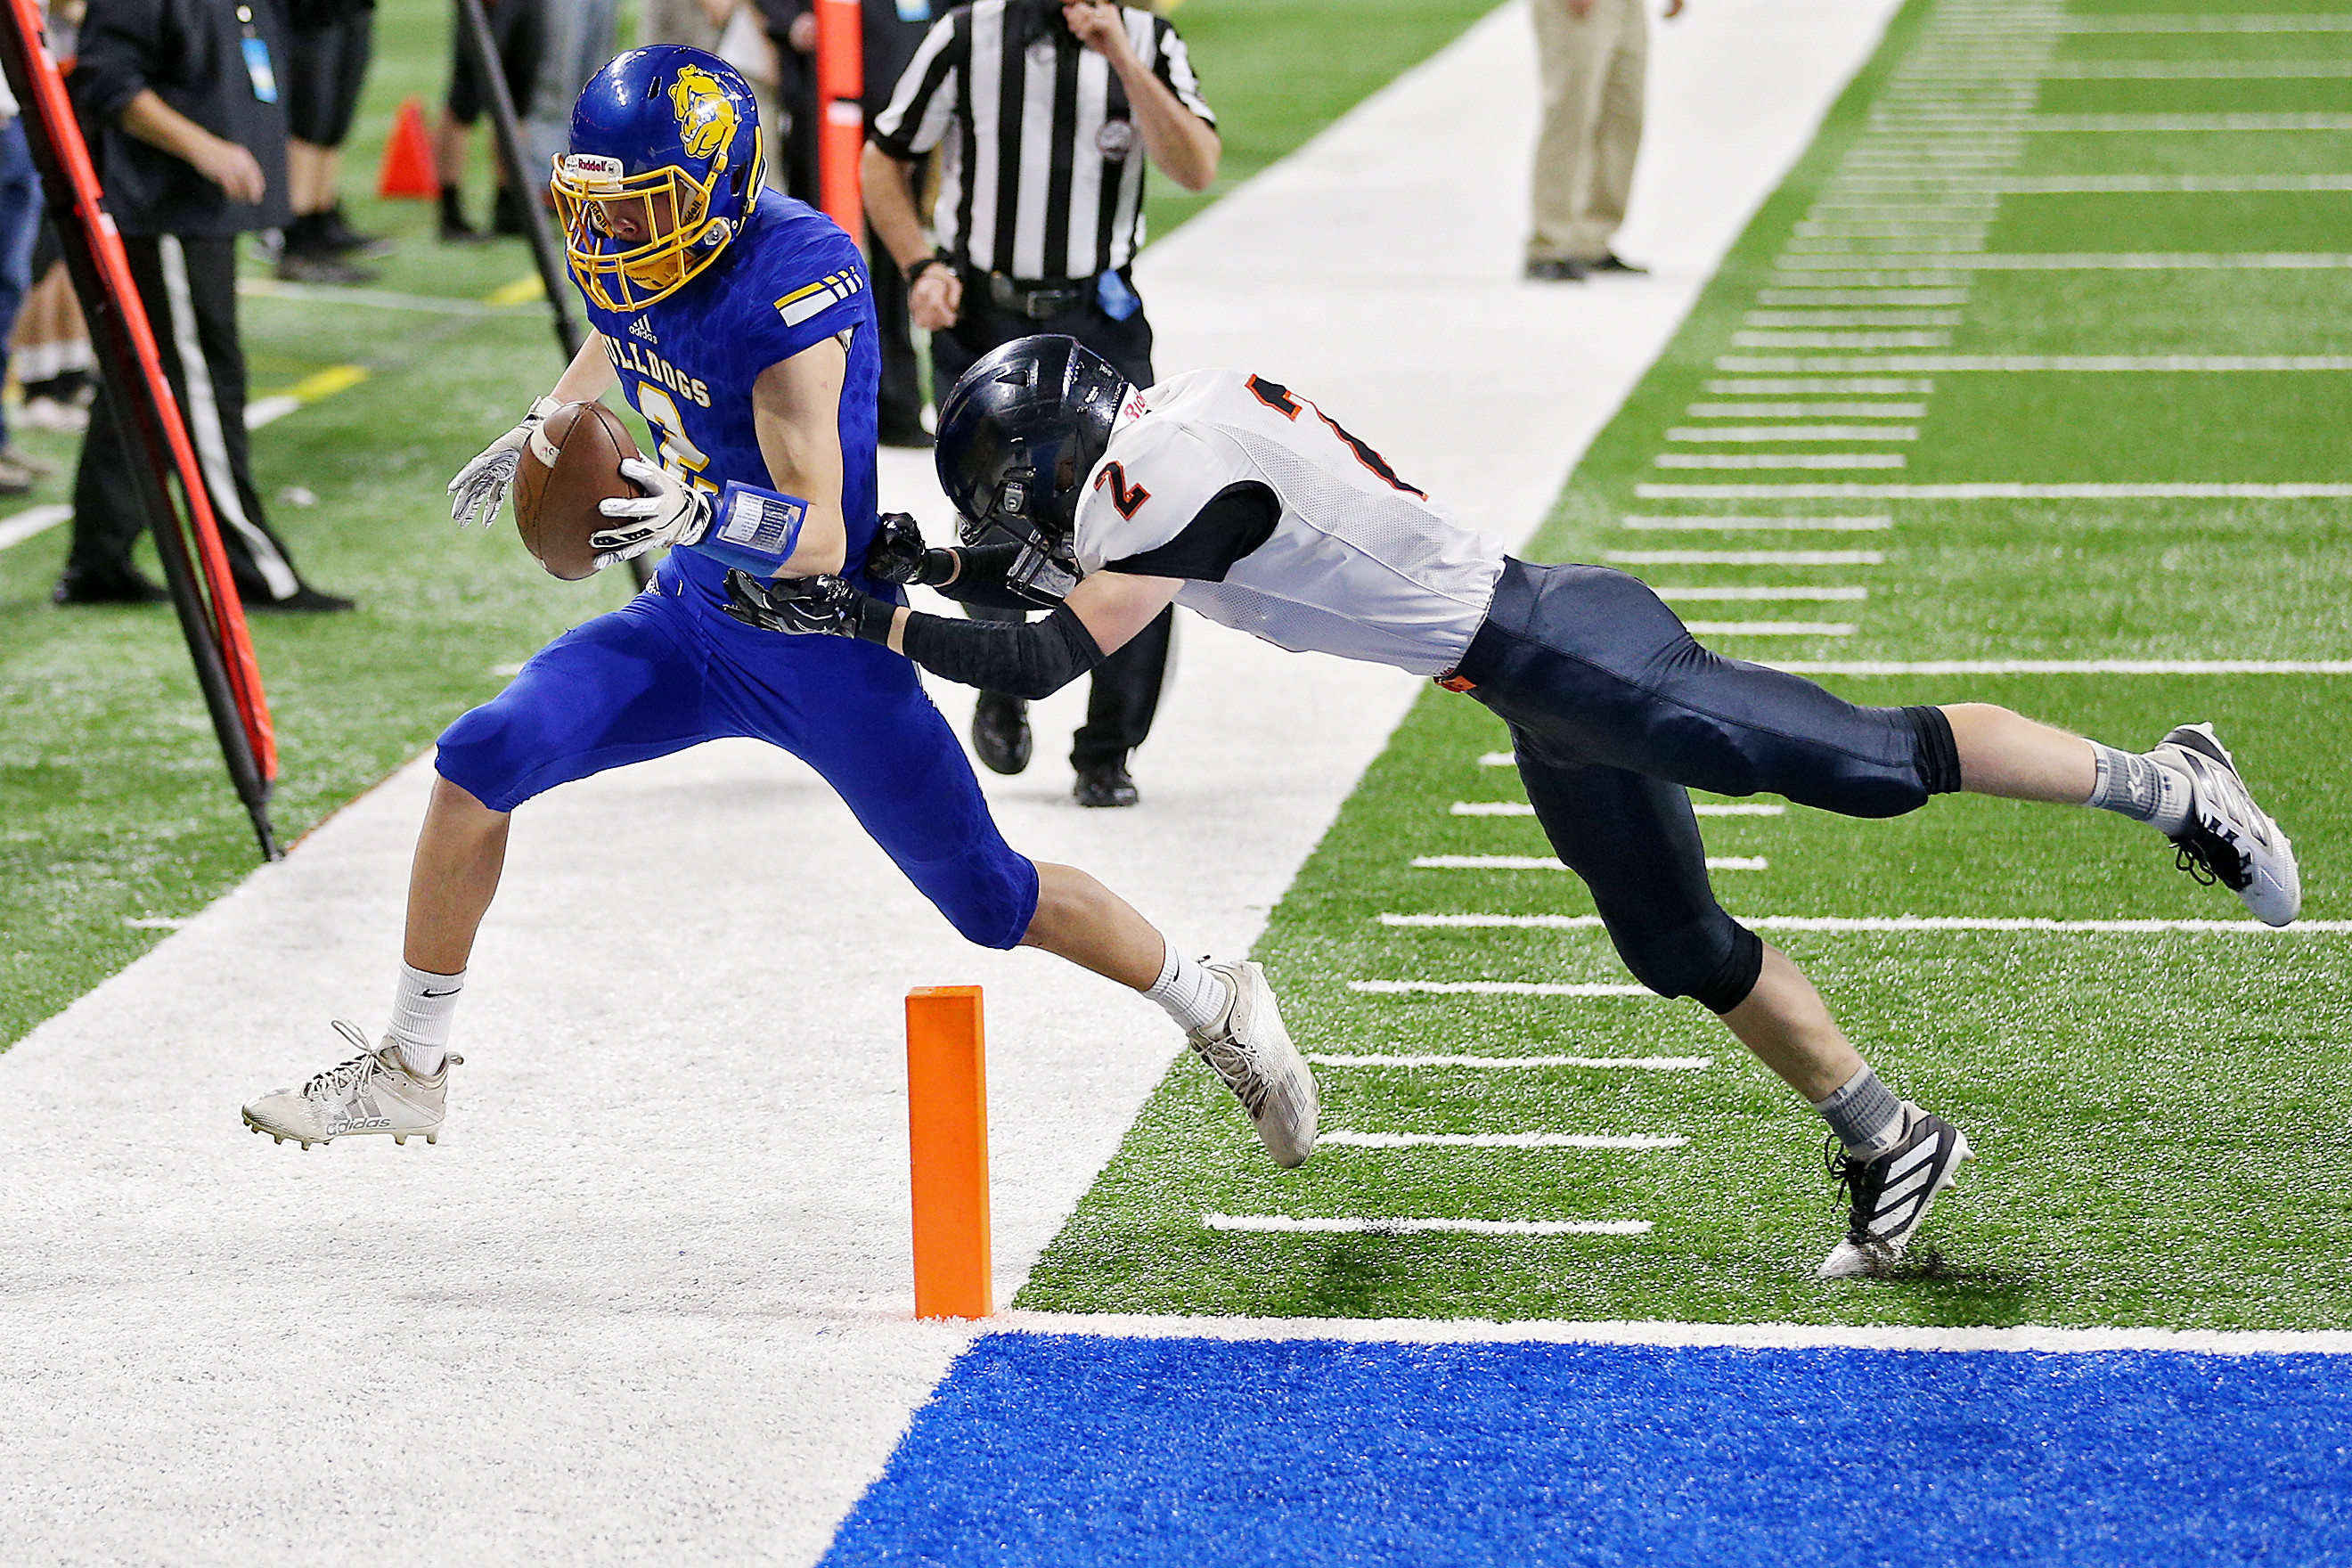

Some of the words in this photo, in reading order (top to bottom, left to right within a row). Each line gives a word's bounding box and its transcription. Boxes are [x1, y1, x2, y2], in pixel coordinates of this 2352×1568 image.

[628, 324, 658, 345] adidas
[600, 333, 712, 408] ULLDOGS
[1093, 458, 1152, 522] 2
[326, 1117, 391, 1136] adidas
